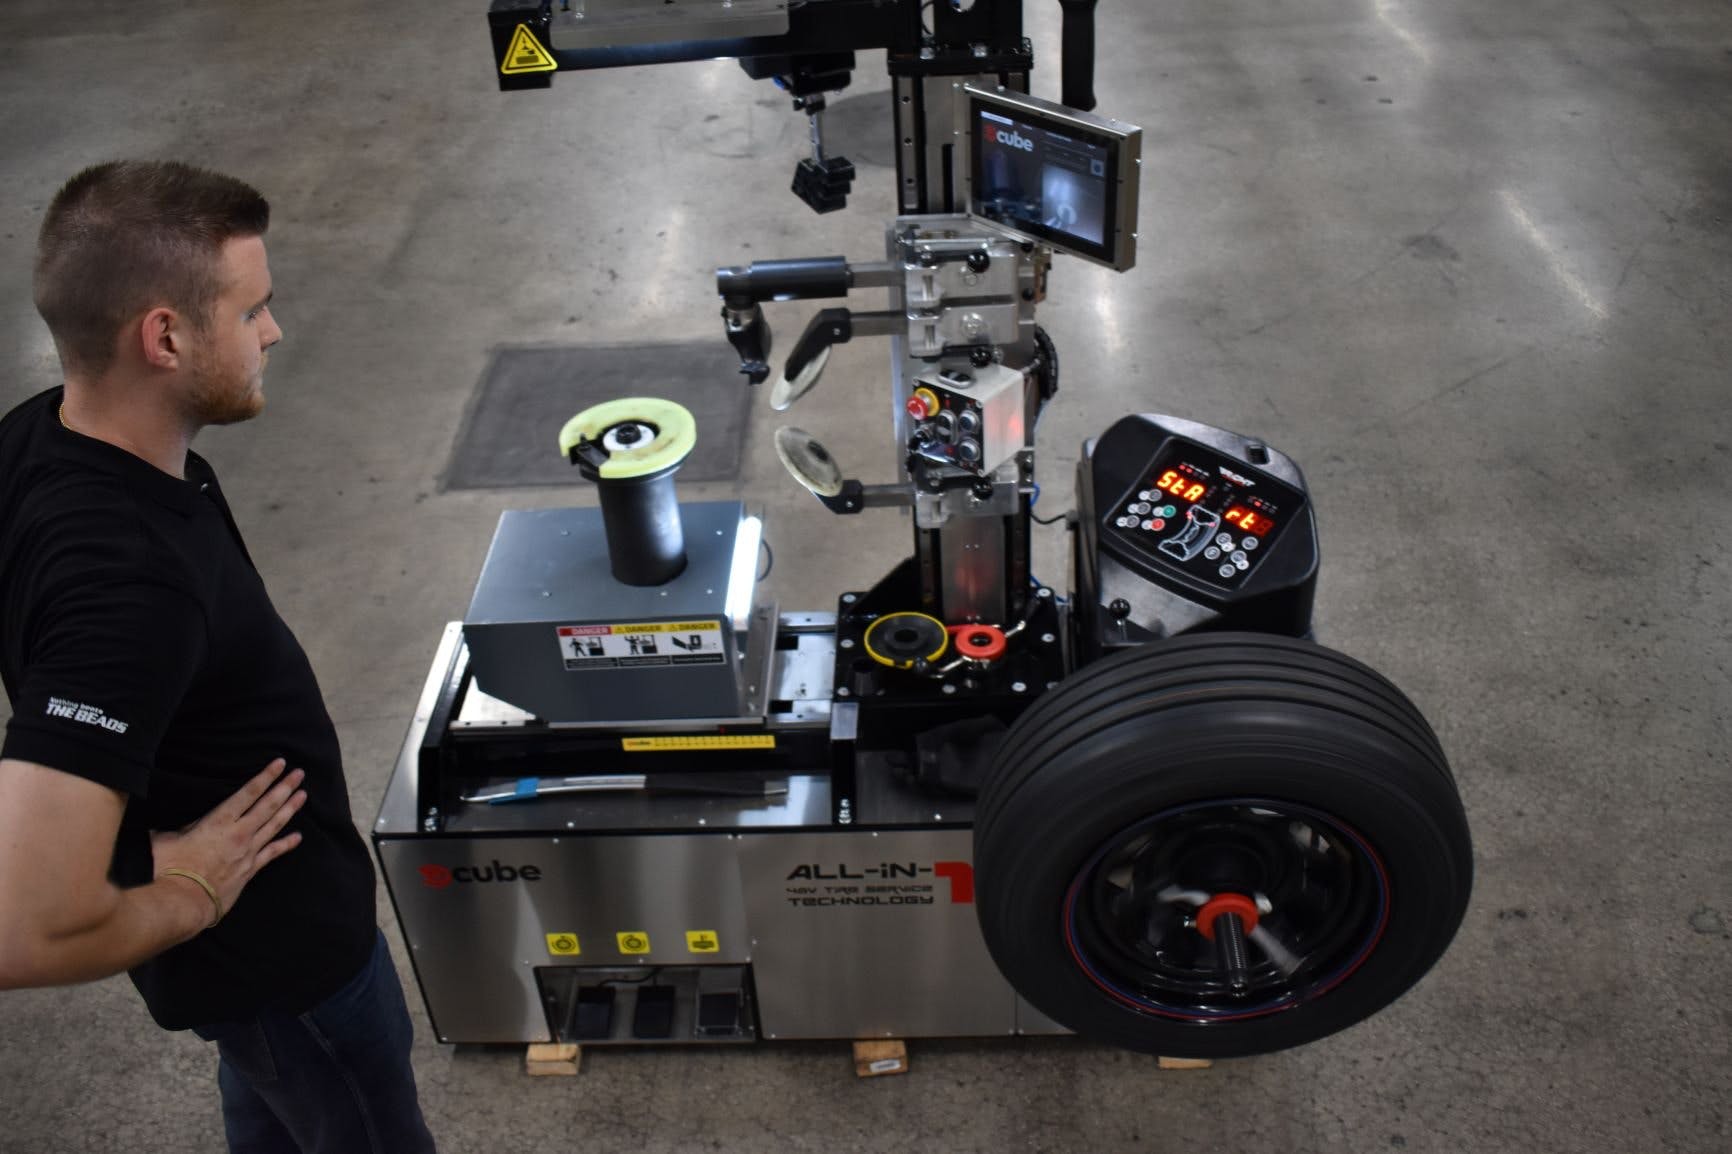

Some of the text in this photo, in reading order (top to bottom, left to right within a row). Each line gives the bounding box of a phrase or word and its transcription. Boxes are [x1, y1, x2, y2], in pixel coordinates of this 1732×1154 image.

[996, 131, 1034, 152] cube
[572, 626, 609, 636] DANGER
[624, 624, 662, 634] DANGER
[679, 622, 716, 632] DANGER
[46, 703, 129, 734] THE BEADS
[453, 859, 542, 883] cube
[787, 895, 934, 907] TECHNOLOGY
